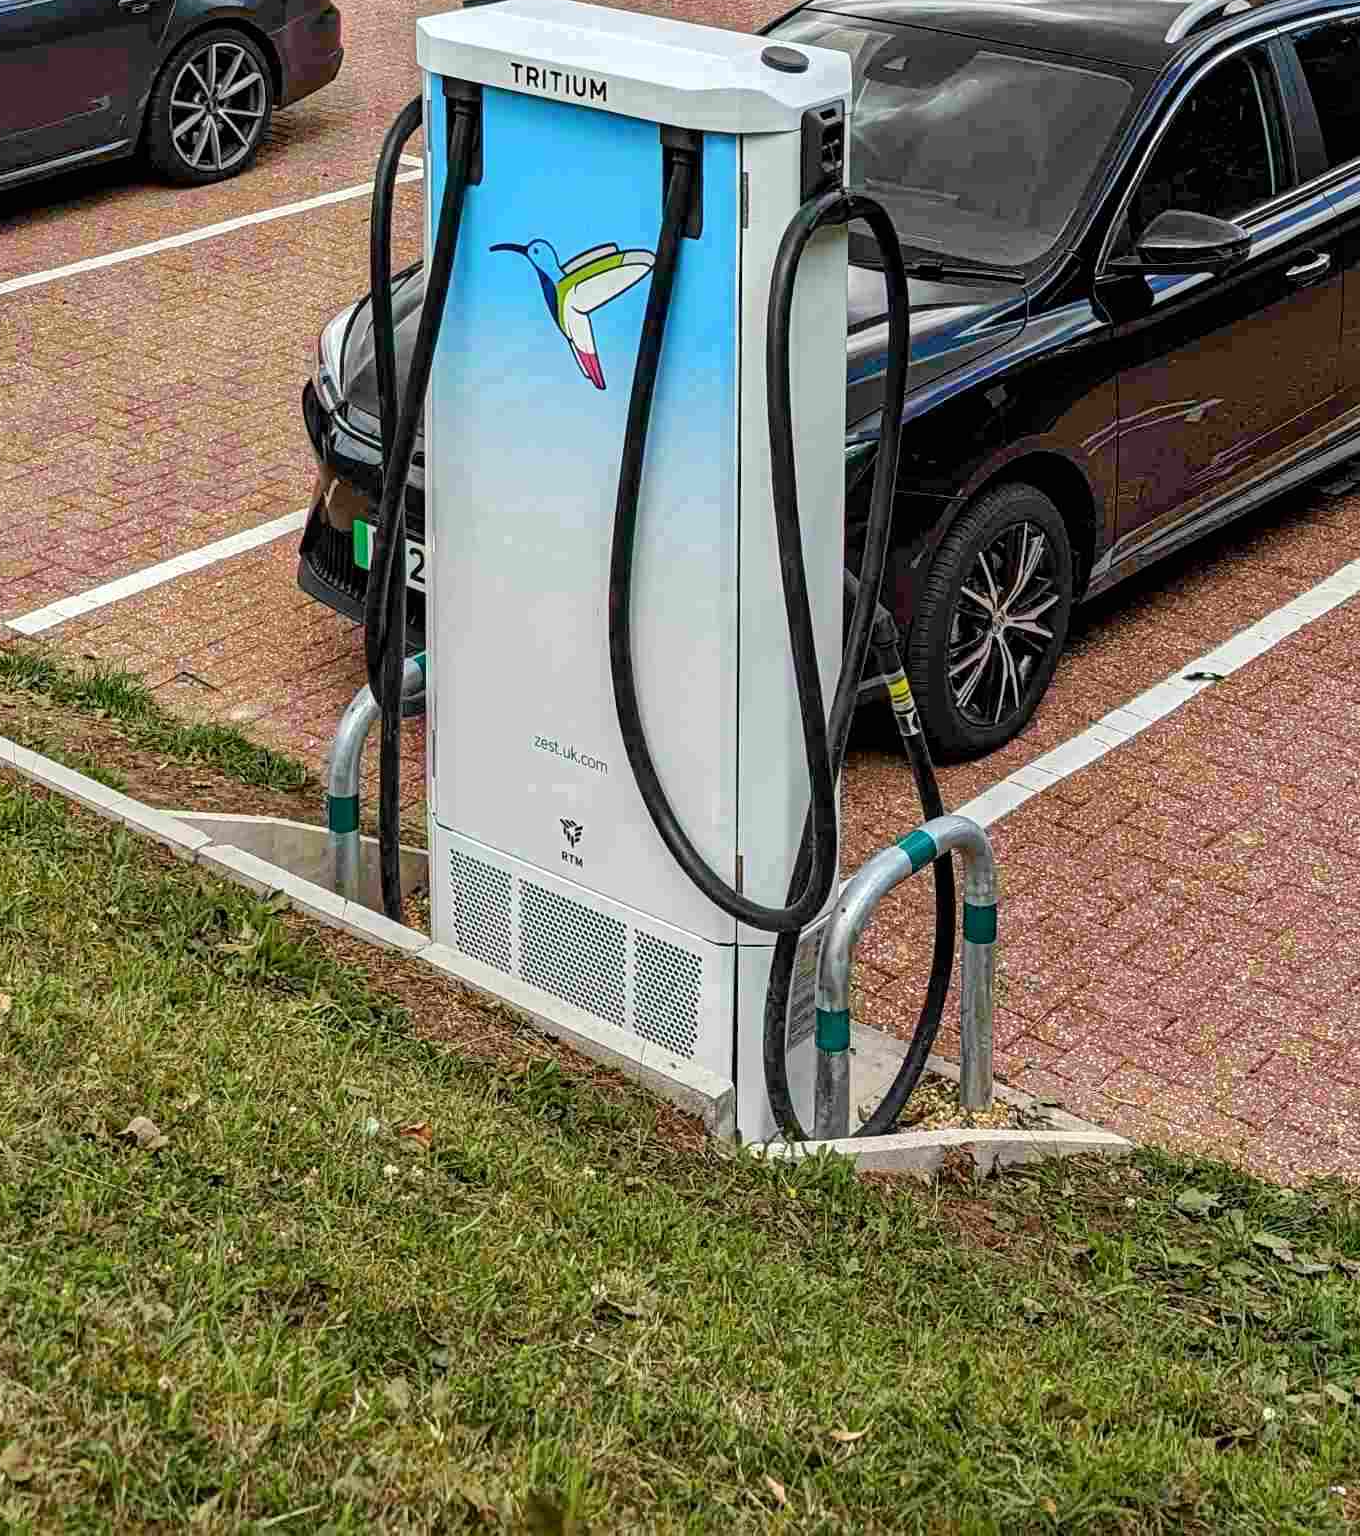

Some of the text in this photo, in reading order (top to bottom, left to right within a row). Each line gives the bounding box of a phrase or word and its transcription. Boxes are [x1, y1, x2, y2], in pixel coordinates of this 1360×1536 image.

[510, 62, 607, 102] TRITIUM
[533, 735, 609, 775] zest.uk.com
[561, 851, 584, 867] RTM
